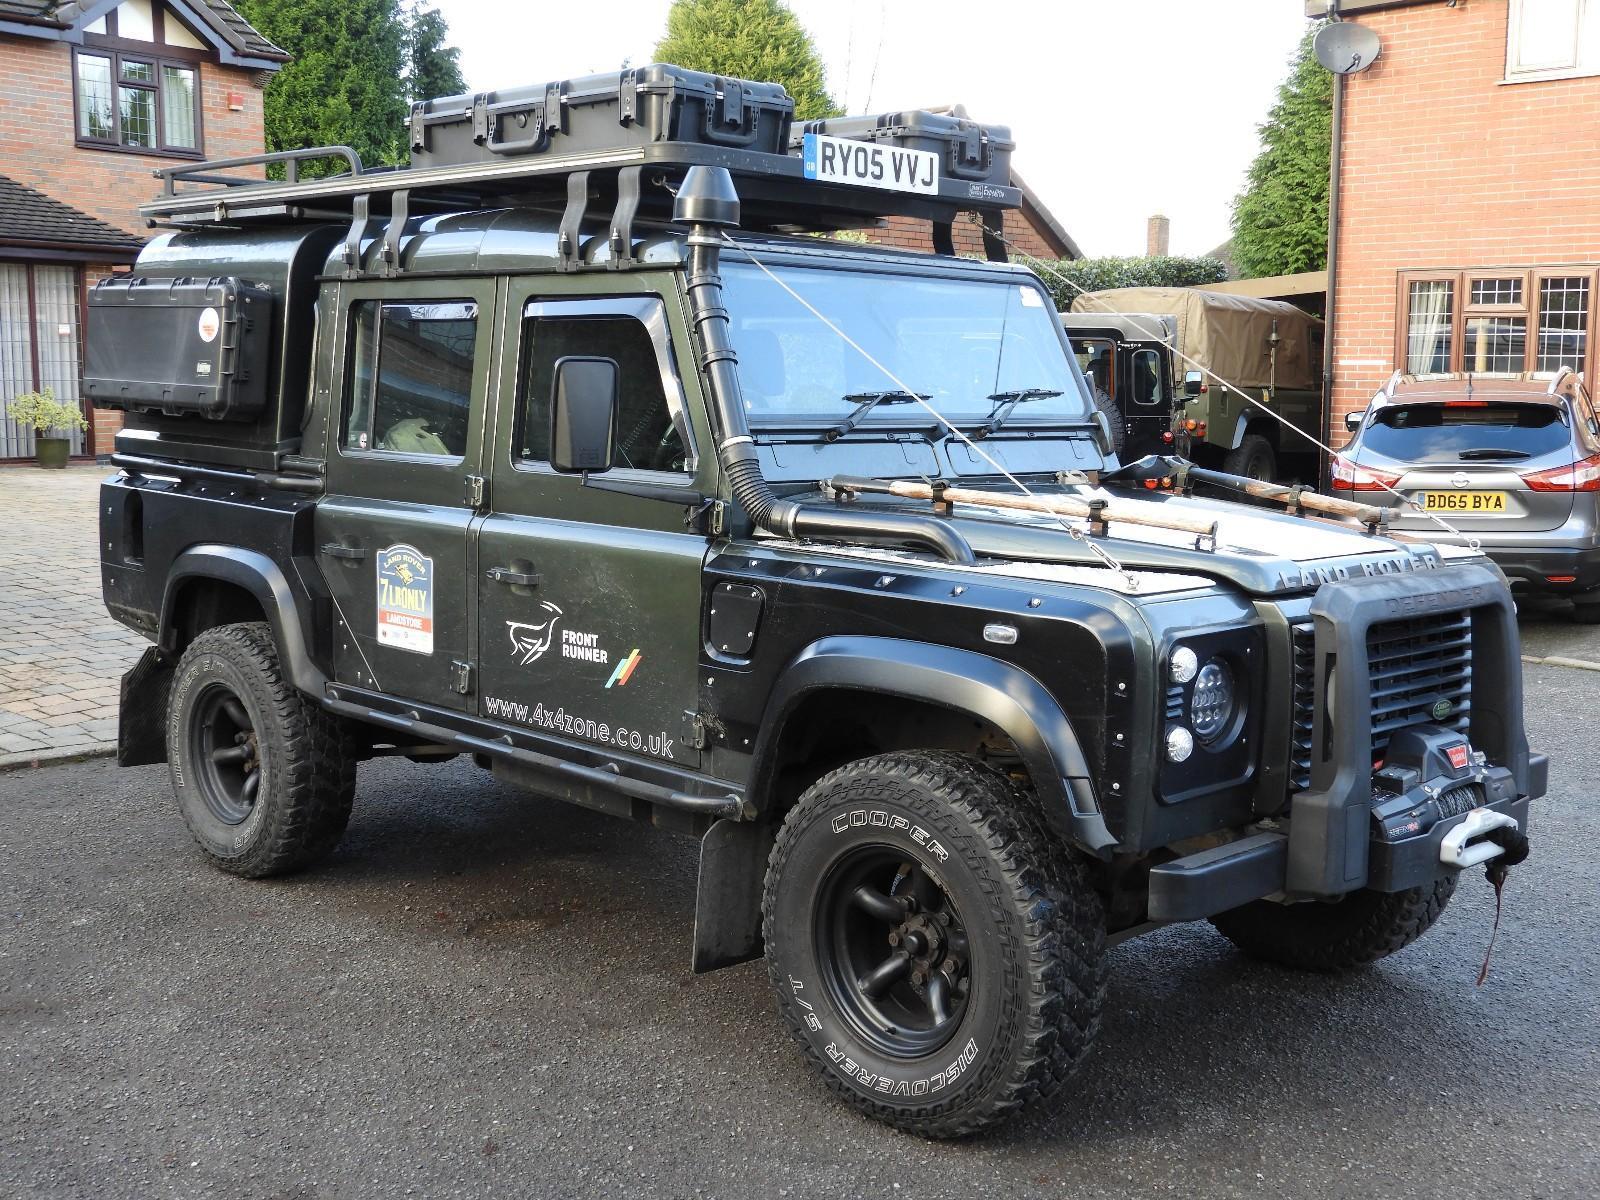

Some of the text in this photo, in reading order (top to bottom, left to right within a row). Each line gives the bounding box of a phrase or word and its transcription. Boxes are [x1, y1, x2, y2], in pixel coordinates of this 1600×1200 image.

[821, 142, 934, 187] RY05 VVJ
[1427, 494, 1503, 509] BD65 BYA
[384, 554, 426, 575] LAND ROVER
[1279, 554, 1438, 589] LAND ROVER
[562, 645, 608, 664] RUNNER
[563, 629, 599, 647] FRONT
[485, 696, 674, 759] www.4x4zone.co.uk
[831, 809, 949, 863] COOPER
[788, 974, 979, 1096] DISCOVERER S/T
